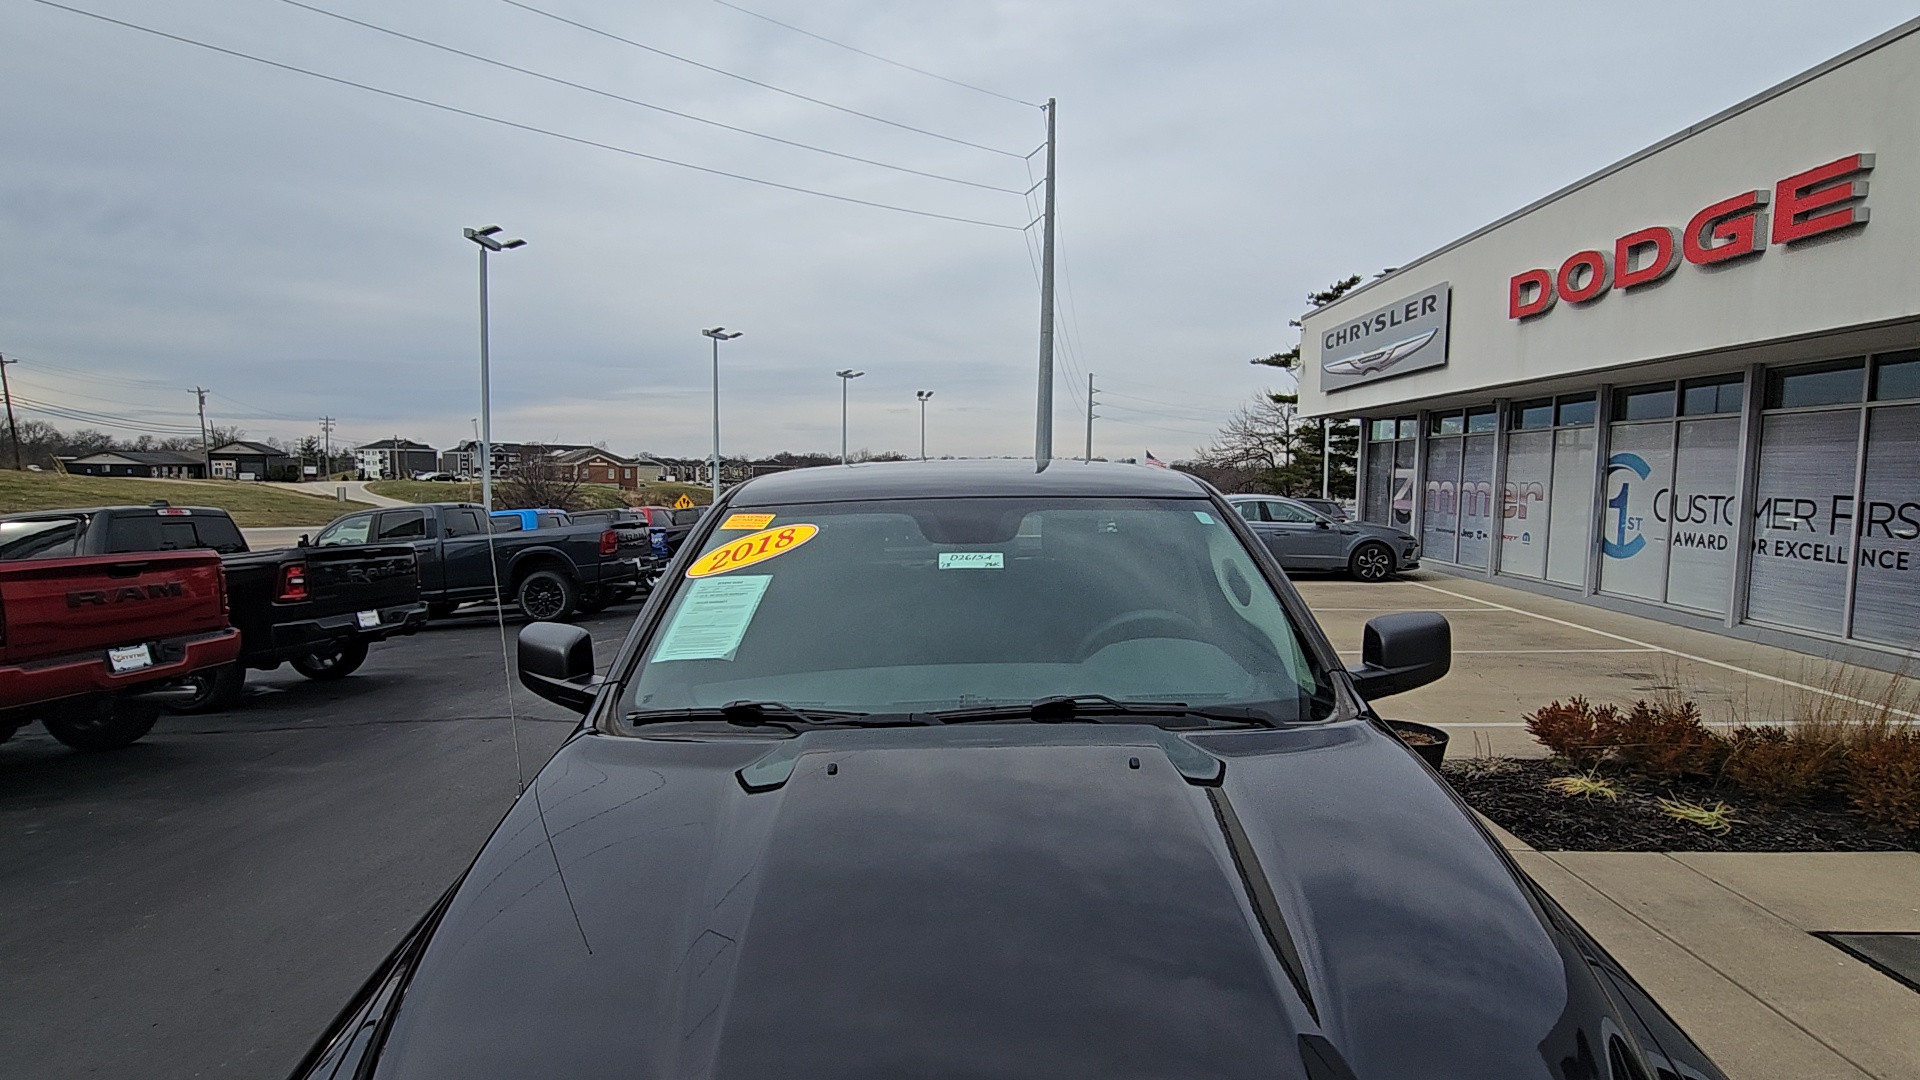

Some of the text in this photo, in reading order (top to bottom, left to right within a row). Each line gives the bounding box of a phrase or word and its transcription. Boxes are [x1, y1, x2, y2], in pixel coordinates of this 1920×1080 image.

[1508, 153, 1875, 319] DODGE
[1325, 294, 1437, 349] CHRYSLER
[1393, 468, 1544, 519] Zmmer
[1829, 495, 1920, 540] FIRS
[707, 528, 796, 572] 2018
[1673, 531, 1728, 550] AWARD
[1774, 540, 1910, 571] EXCELLNCE
[65, 582, 184, 608] RAM
